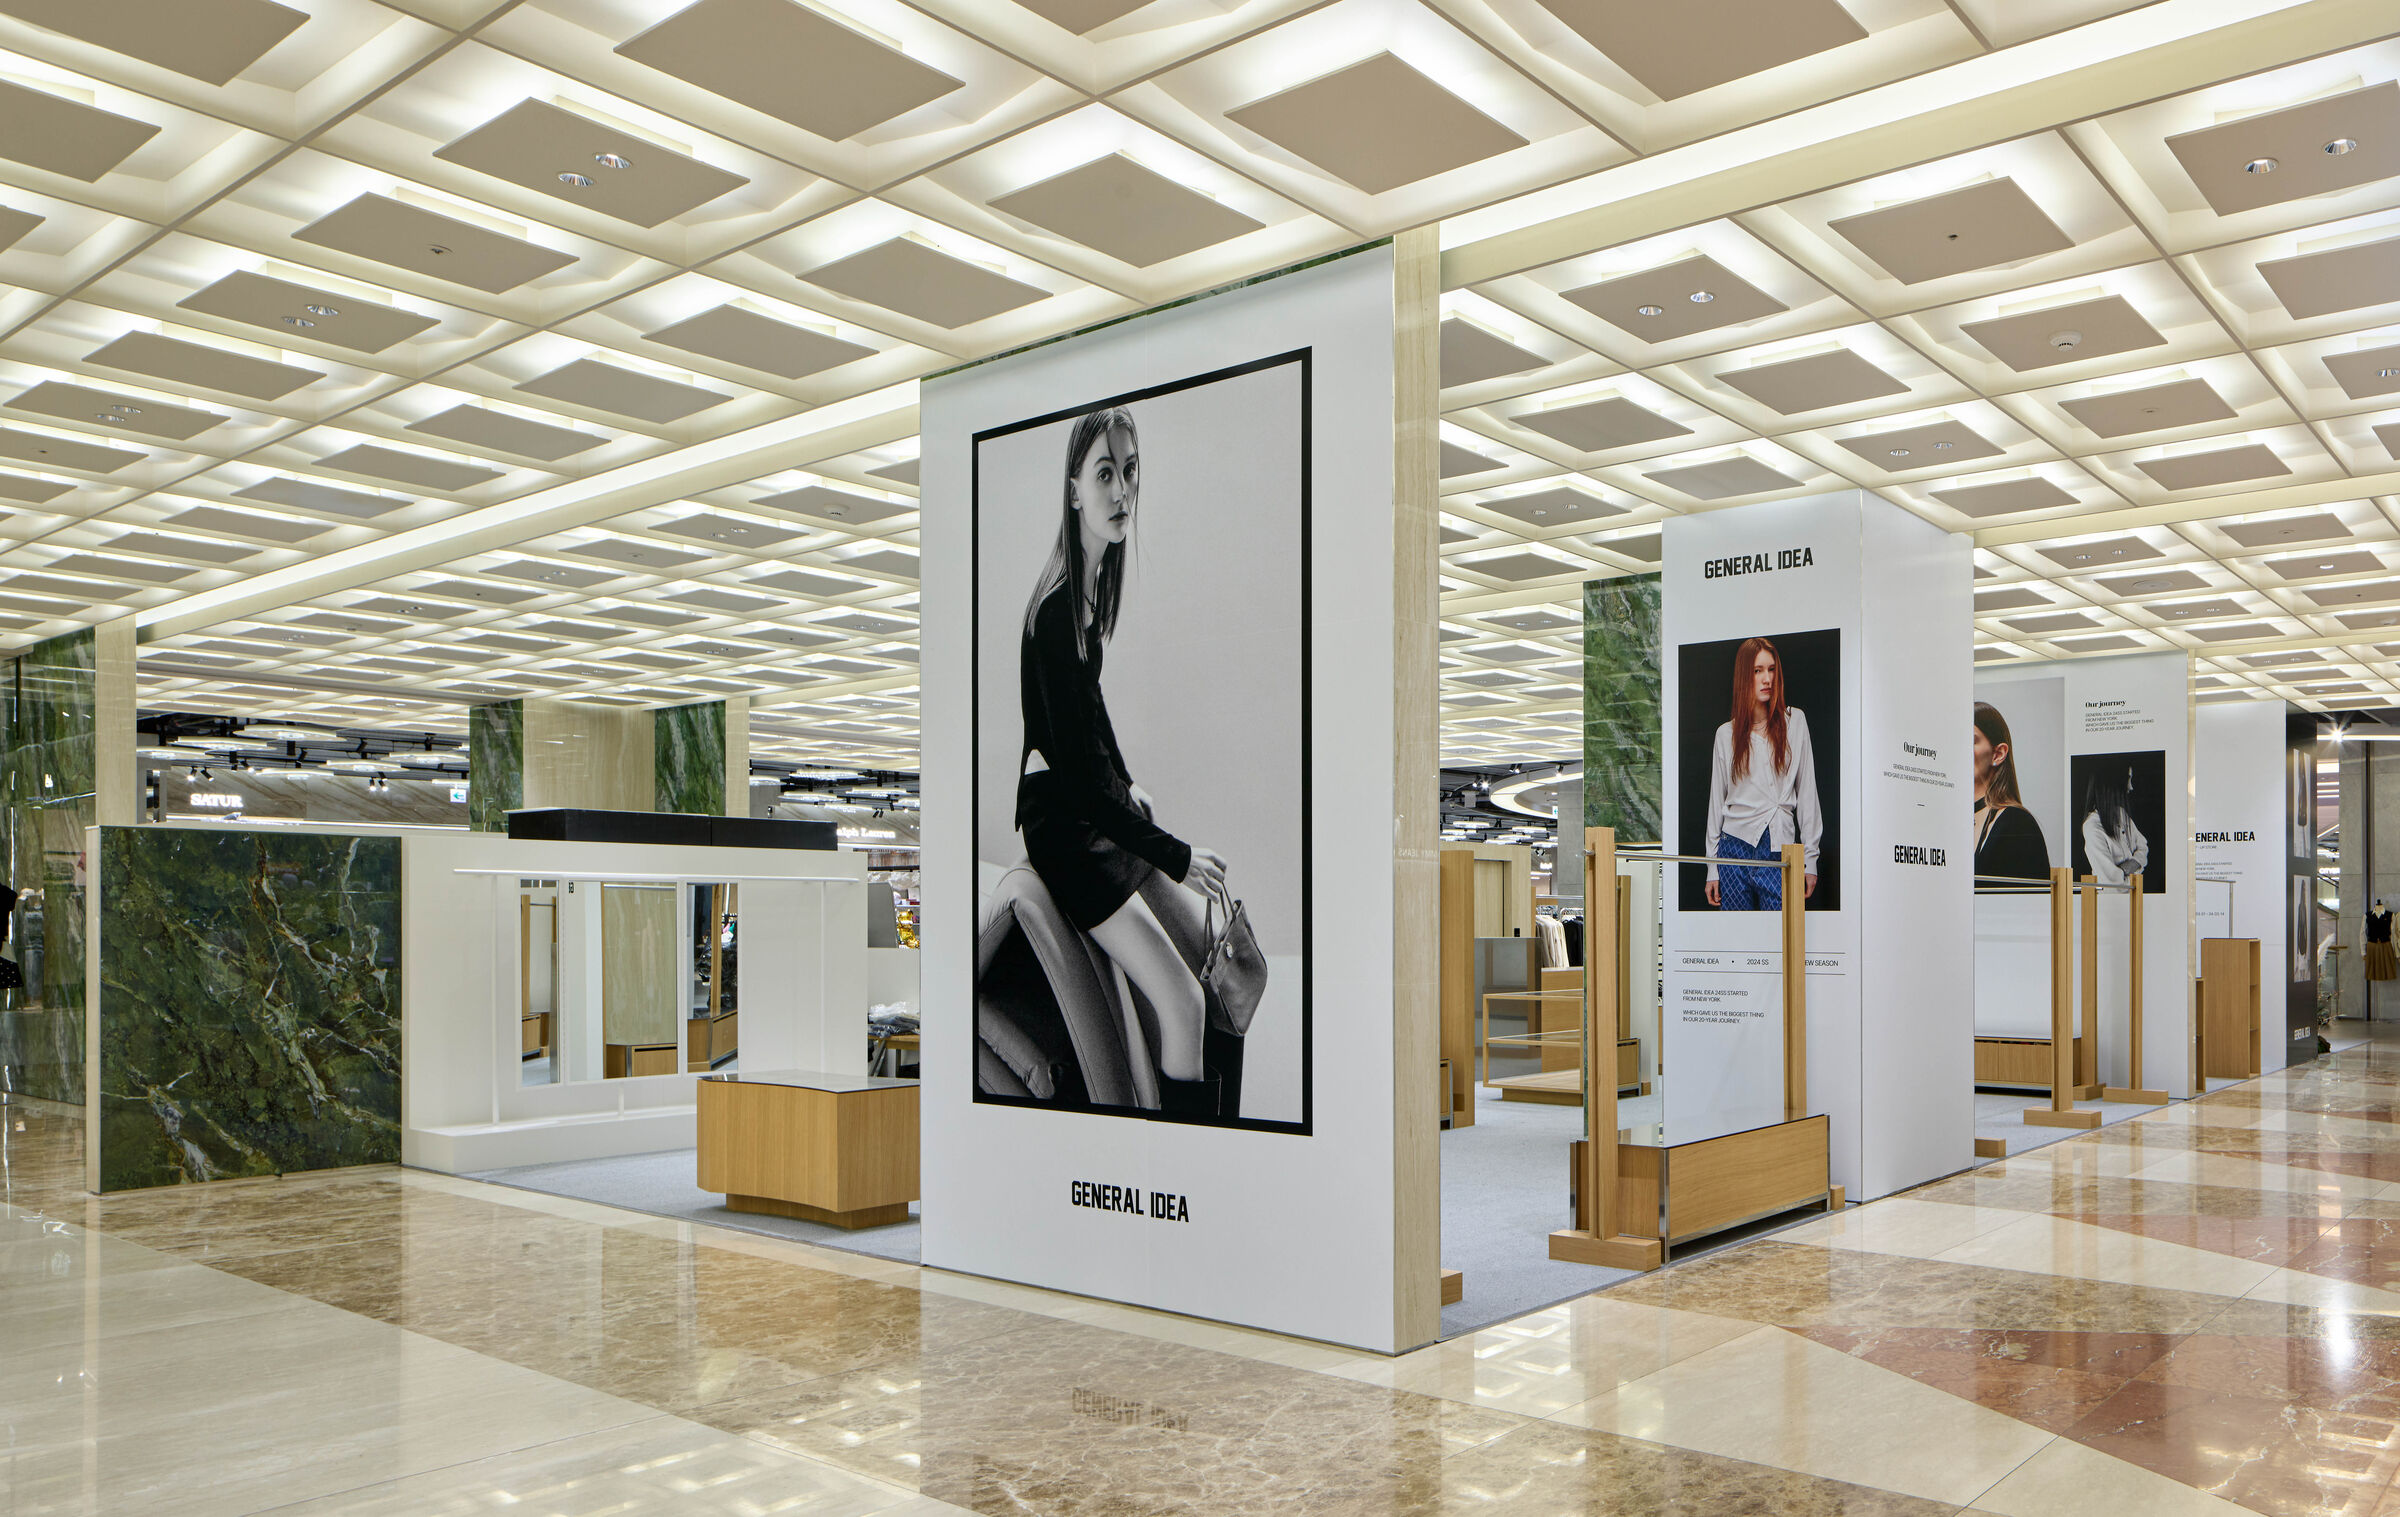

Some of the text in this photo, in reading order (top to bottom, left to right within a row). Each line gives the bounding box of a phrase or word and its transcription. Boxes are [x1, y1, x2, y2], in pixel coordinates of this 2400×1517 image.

[1704, 547, 1814, 579] GENERAL IDEA
[2098, 700, 2126, 708] journey
[1903, 741, 1937, 760] Our journey
[190, 793, 244, 808] SATUR
[836, 826, 896, 839] alph Lauren
[2195, 831, 2256, 842] ENERAL IDEA
[1894, 844, 1947, 867] GENERAL IDEA
[1682, 957, 1706, 965] GENERAL
[1746, 958, 1761, 966] 2024
[1761, 958, 1770, 966] SS
[1071, 1180, 1190, 1223] GENERAL IDEA
